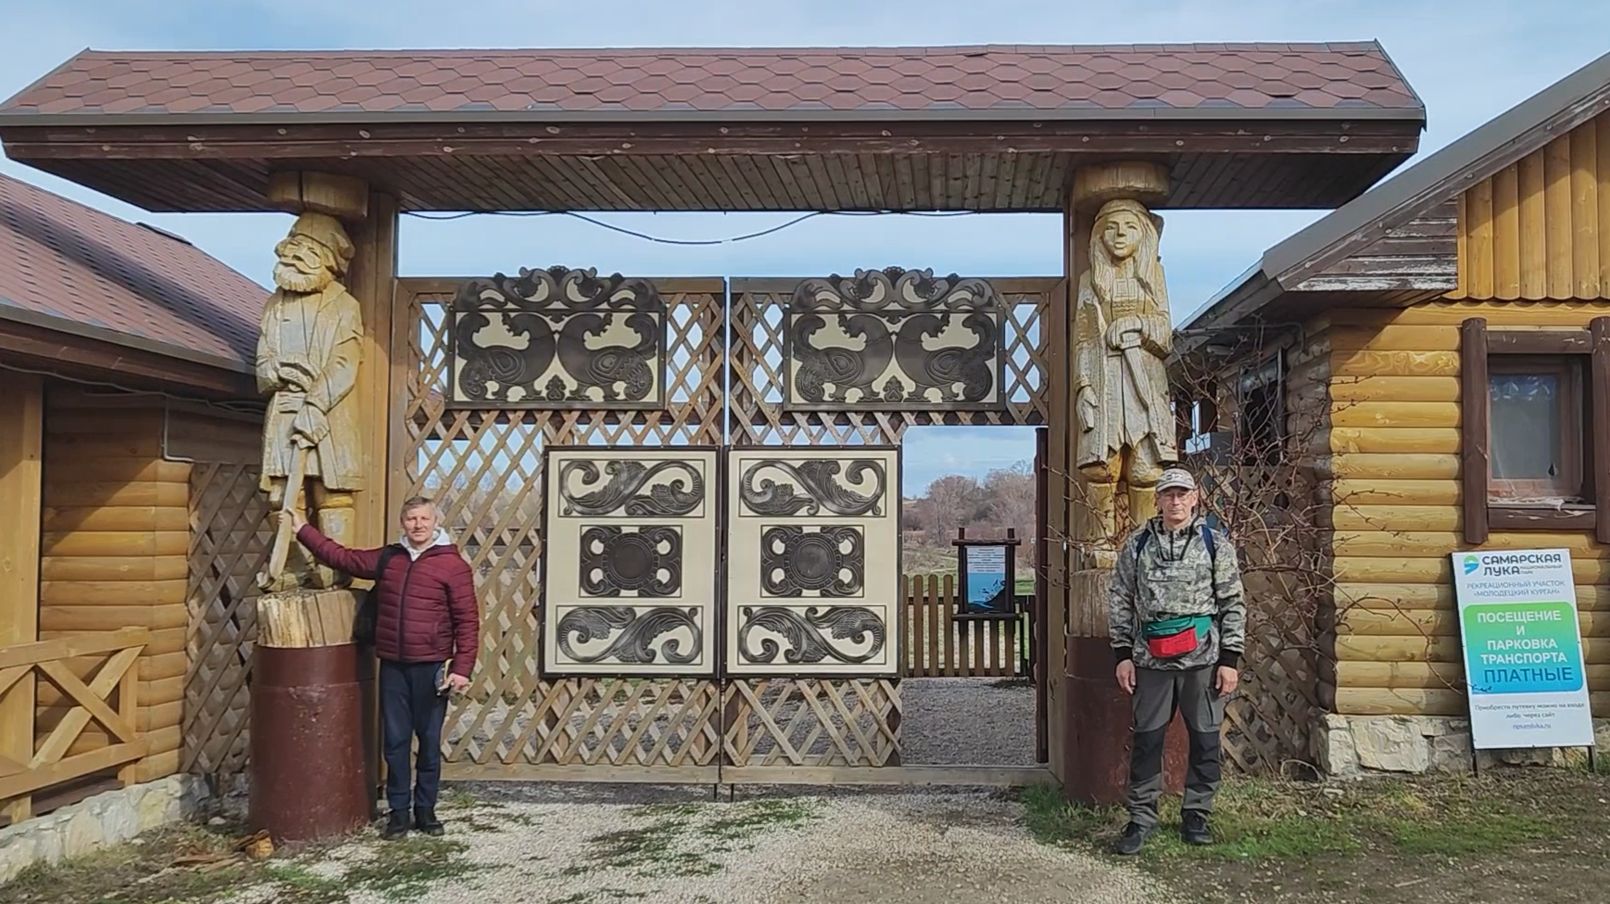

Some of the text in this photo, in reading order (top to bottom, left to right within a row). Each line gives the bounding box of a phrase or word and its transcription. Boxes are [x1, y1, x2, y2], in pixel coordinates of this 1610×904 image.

[1482, 554, 1561, 565] САМАРСКАЯ
[1483, 566, 1520, 577] ЛУКА
[1466, 580, 1565, 589] РЕКРЕАЦИОННЫЙ УЧАСТОК
[1473, 588, 1530, 597] «МОЛОДЕЦКИЙ
[1477, 610, 1562, 623] ПОСЕЩЕНИЕ
[1516, 625, 1525, 636] И
[1487, 638, 1558, 651] ПАРКОВКА
[1481, 652, 1568, 665] ТРАНСПОРТА
[1484, 667, 1573, 683] ПЛАТНЫЕ
[1474, 704, 1511, 712] Приобрести
